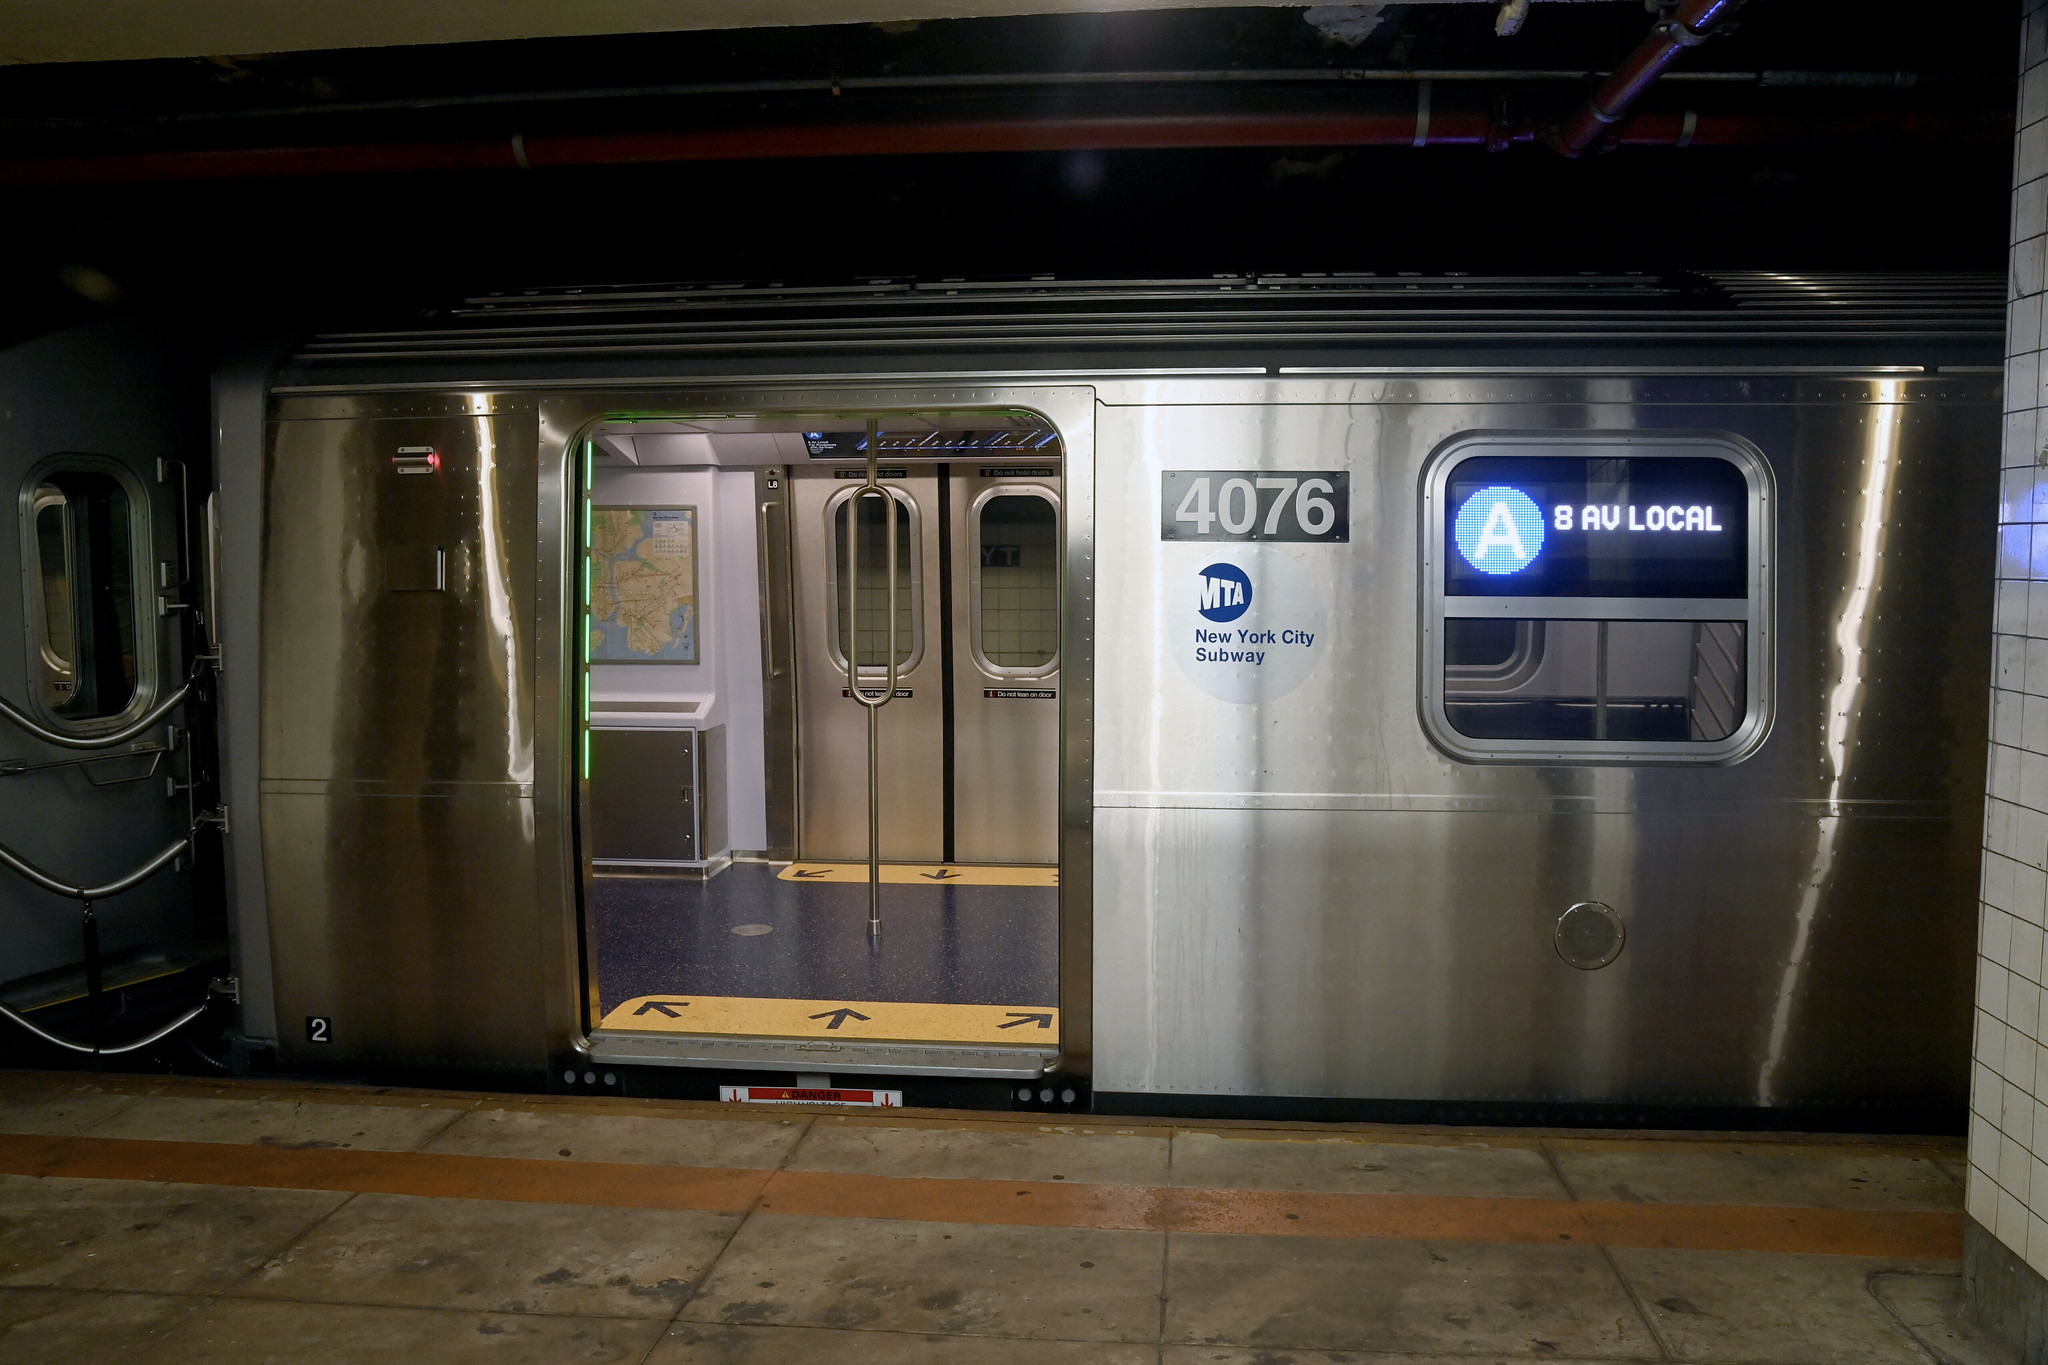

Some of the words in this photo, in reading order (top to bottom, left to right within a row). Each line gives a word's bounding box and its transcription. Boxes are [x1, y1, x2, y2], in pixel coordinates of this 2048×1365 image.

[768, 480, 778, 489] L8
[1175, 477, 1336, 536] 4076
[1554, 505, 1573, 531] 8
[1582, 505, 1620, 531] AV
[1629, 505, 1722, 531] LOCAL
[1475, 501, 1527, 559] A
[1198, 574, 1244, 611] MTA
[1195, 629, 1232, 644] New
[1237, 629, 1276, 644] York
[1282, 629, 1315, 647] City
[1195, 648, 1266, 665] Subway
[311, 1018, 327, 1042] 2
[791, 1090, 841, 1100] DANGER
